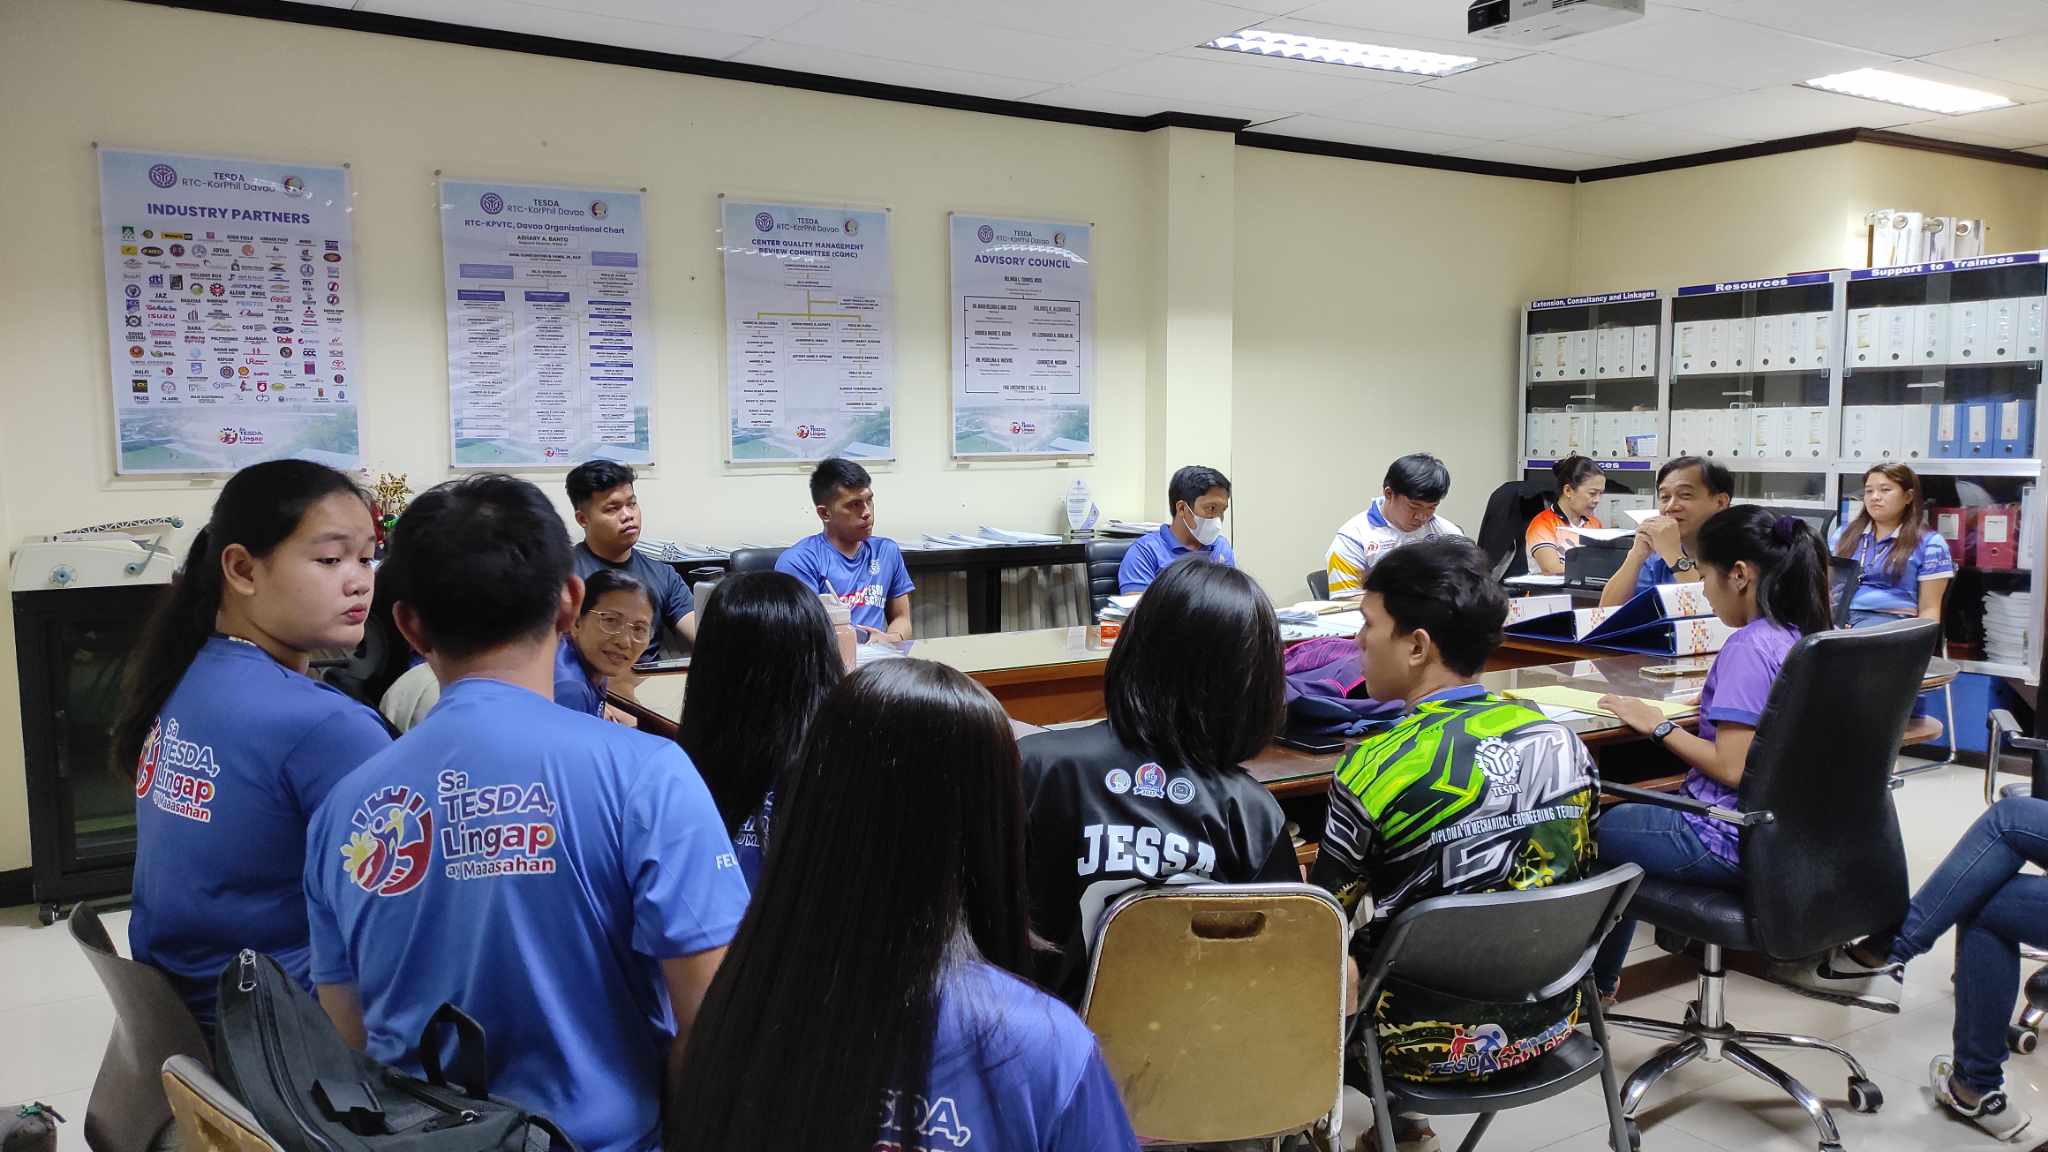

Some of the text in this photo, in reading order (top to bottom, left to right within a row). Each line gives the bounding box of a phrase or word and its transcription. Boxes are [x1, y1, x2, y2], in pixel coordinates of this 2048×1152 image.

[182, 178, 241, 190] RTC-KarPhil
[214, 172, 245, 182] TESDA
[534, 199, 559, 207] TESDA
[559, 208, 585, 217] Davao
[147, 203, 311, 224] INDUSTRY PARTNERS
[516, 222, 543, 230] Davao
[544, 223, 602, 233] Organizational
[603, 226, 625, 234] Chart
[751, 239, 864, 250] CENTER QUALITY MANAGEMENT
[758, 247, 788, 255] REVIEW
[789, 248, 831, 257] COMMITTEE
[974, 254, 1071, 269] ADVISORY COUNCIL
[1871, 256, 2014, 277] Support to Trainees
[1715, 278, 1788, 292] Resources
[1532, 299, 1566, 309] Extension,
[1567, 296, 1608, 305] Consultancy
[1623, 290, 1655, 300] Linkages
[166, 718, 179, 738] Sa
[161, 736, 220, 777] TESDA,
[154, 762, 215, 805] Lingap
[437, 769, 468, 794] Sa
[1490, 784, 1522, 798] TESDA
[438, 783, 556, 824] TESDA,
[1431, 824, 1463, 845] DIPLOMA
[1471, 815, 1511, 834] MECHANICAL
[1512, 807, 1555, 827] ENGINEERING
[440, 822, 556, 863] Lingap
[445, 857, 556, 880] ay Maaasahan
